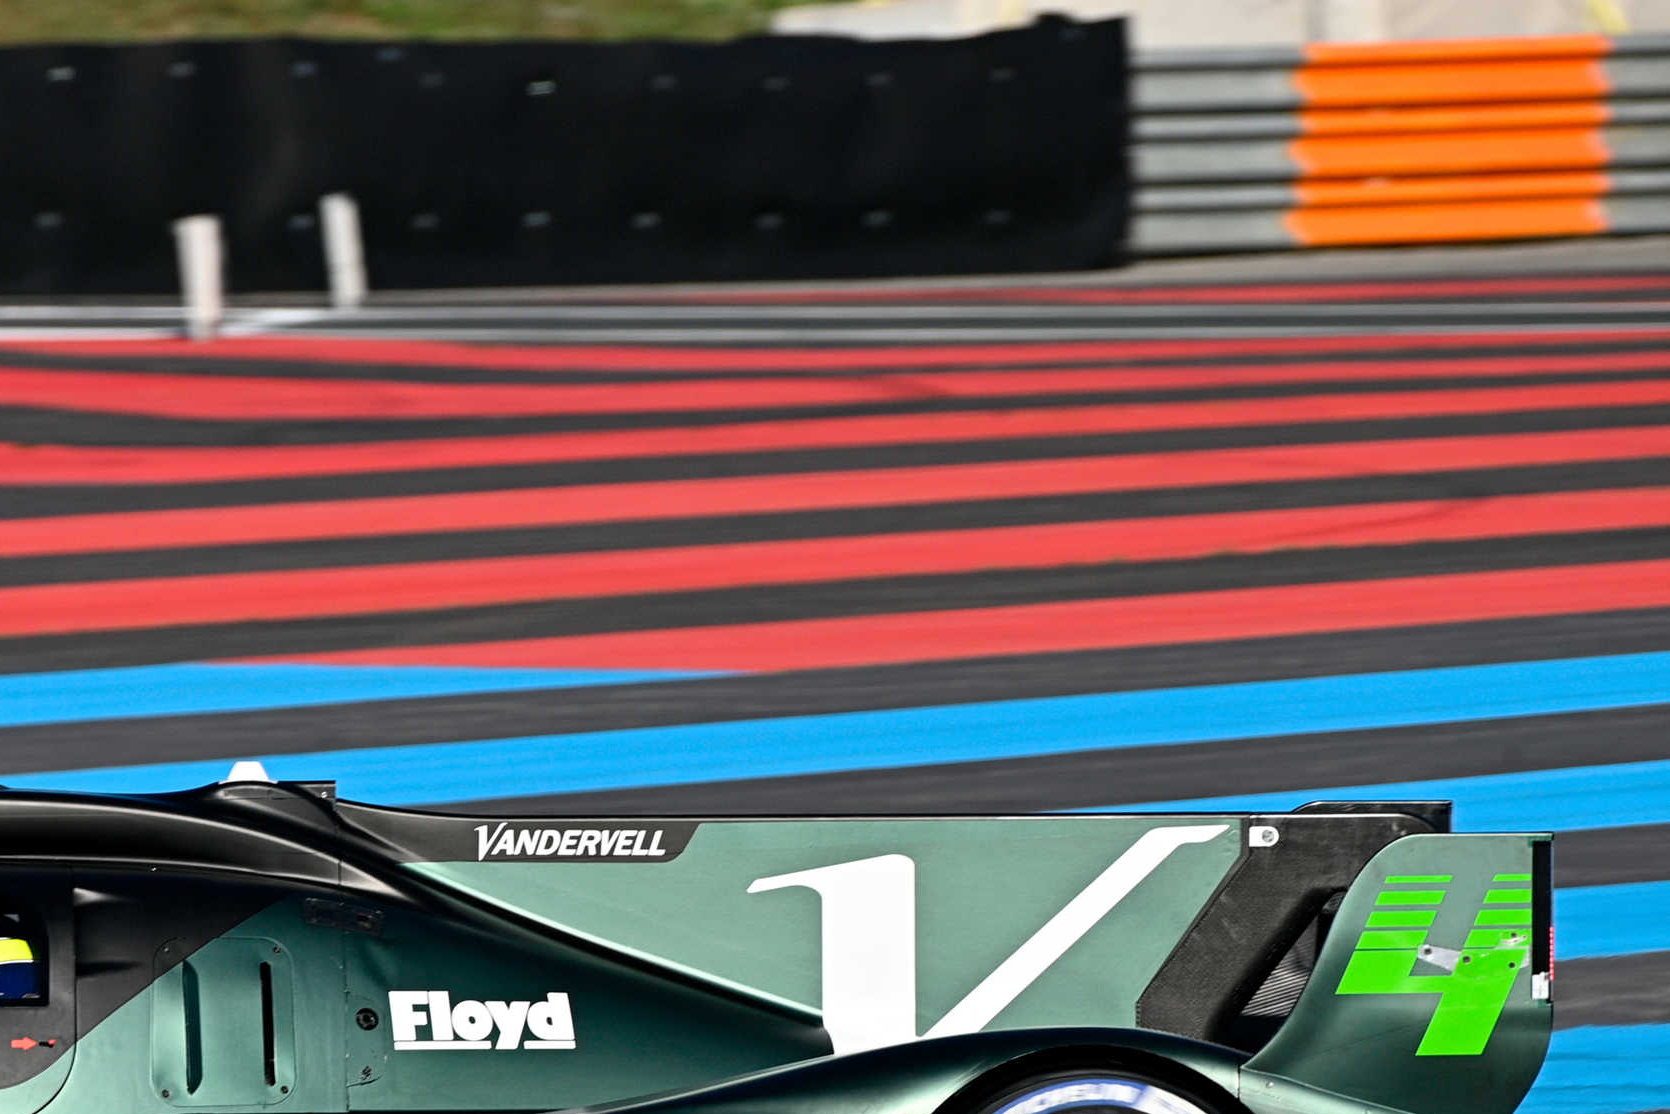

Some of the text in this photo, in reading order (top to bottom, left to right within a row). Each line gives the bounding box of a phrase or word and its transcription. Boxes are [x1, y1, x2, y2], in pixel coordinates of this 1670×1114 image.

[474, 822, 666, 861] VANDERVELL
[1335, 873, 1532, 1056] 4
[388, 990, 577, 1050] Floyd
